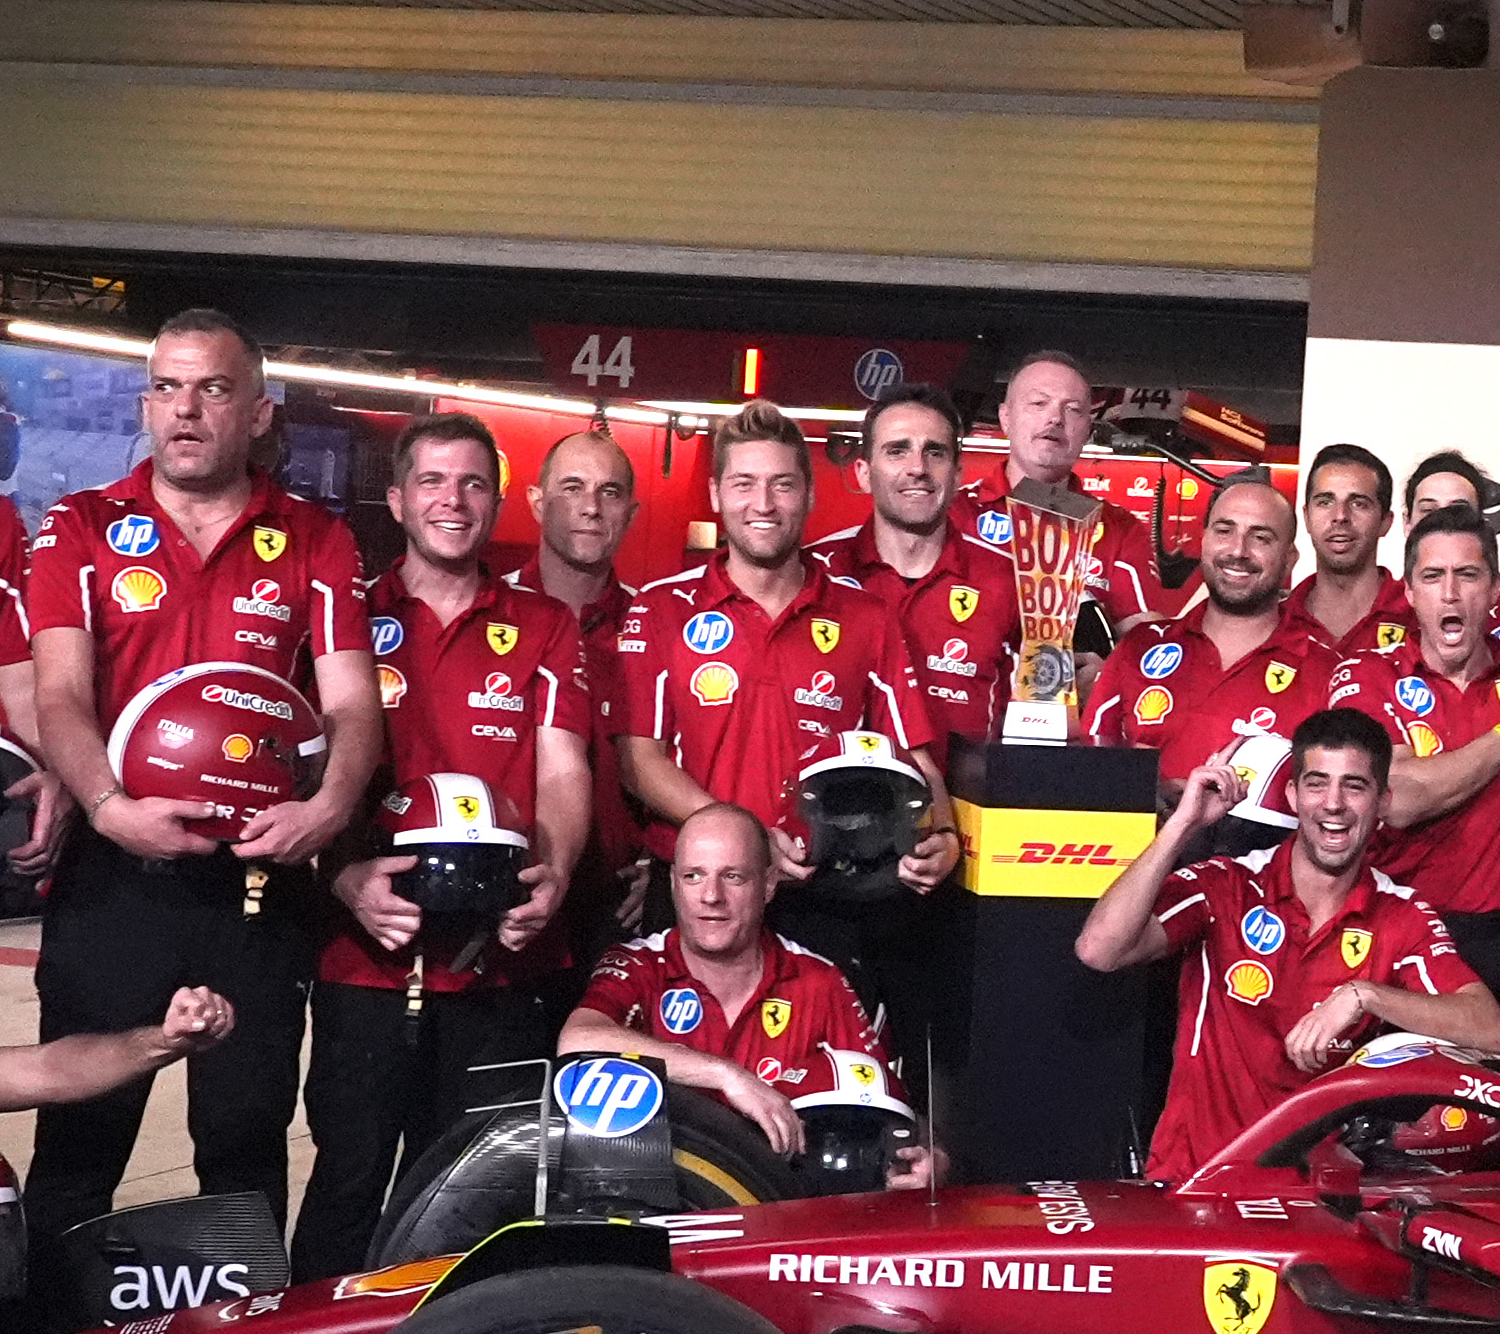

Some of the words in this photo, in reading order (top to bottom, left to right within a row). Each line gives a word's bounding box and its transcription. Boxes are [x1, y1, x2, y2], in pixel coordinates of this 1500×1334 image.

[570, 333, 636, 389] 44
[861, 349, 898, 400] hp
[113, 514, 155, 557] hp
[980, 510, 1011, 544] hp
[233, 597, 290, 622] UniCredit
[235, 630, 278, 647] CEVA
[689, 611, 729, 654] hp
[928, 654, 977, 678] UniCredit
[1145, 642, 1179, 679] hp
[223, 688, 294, 720] UniCredit
[795, 688, 843, 712] UniCredit
[928, 686, 969, 701] CEVA
[159, 718, 194, 739] ITALIA
[472, 724, 518, 738] CEVA
[1021, 716, 1051, 726] DHL
[201, 773, 249, 789] RICHARD
[1019, 842, 1116, 866] DHL
[1246, 905, 1281, 955] hp
[663, 988, 700, 1034] hp
[568, 1056, 652, 1138] hp
[109, 1263, 251, 1311] aws
[768, 1253, 966, 1289] RICHARD
[982, 1259, 1114, 1294] MILLE
